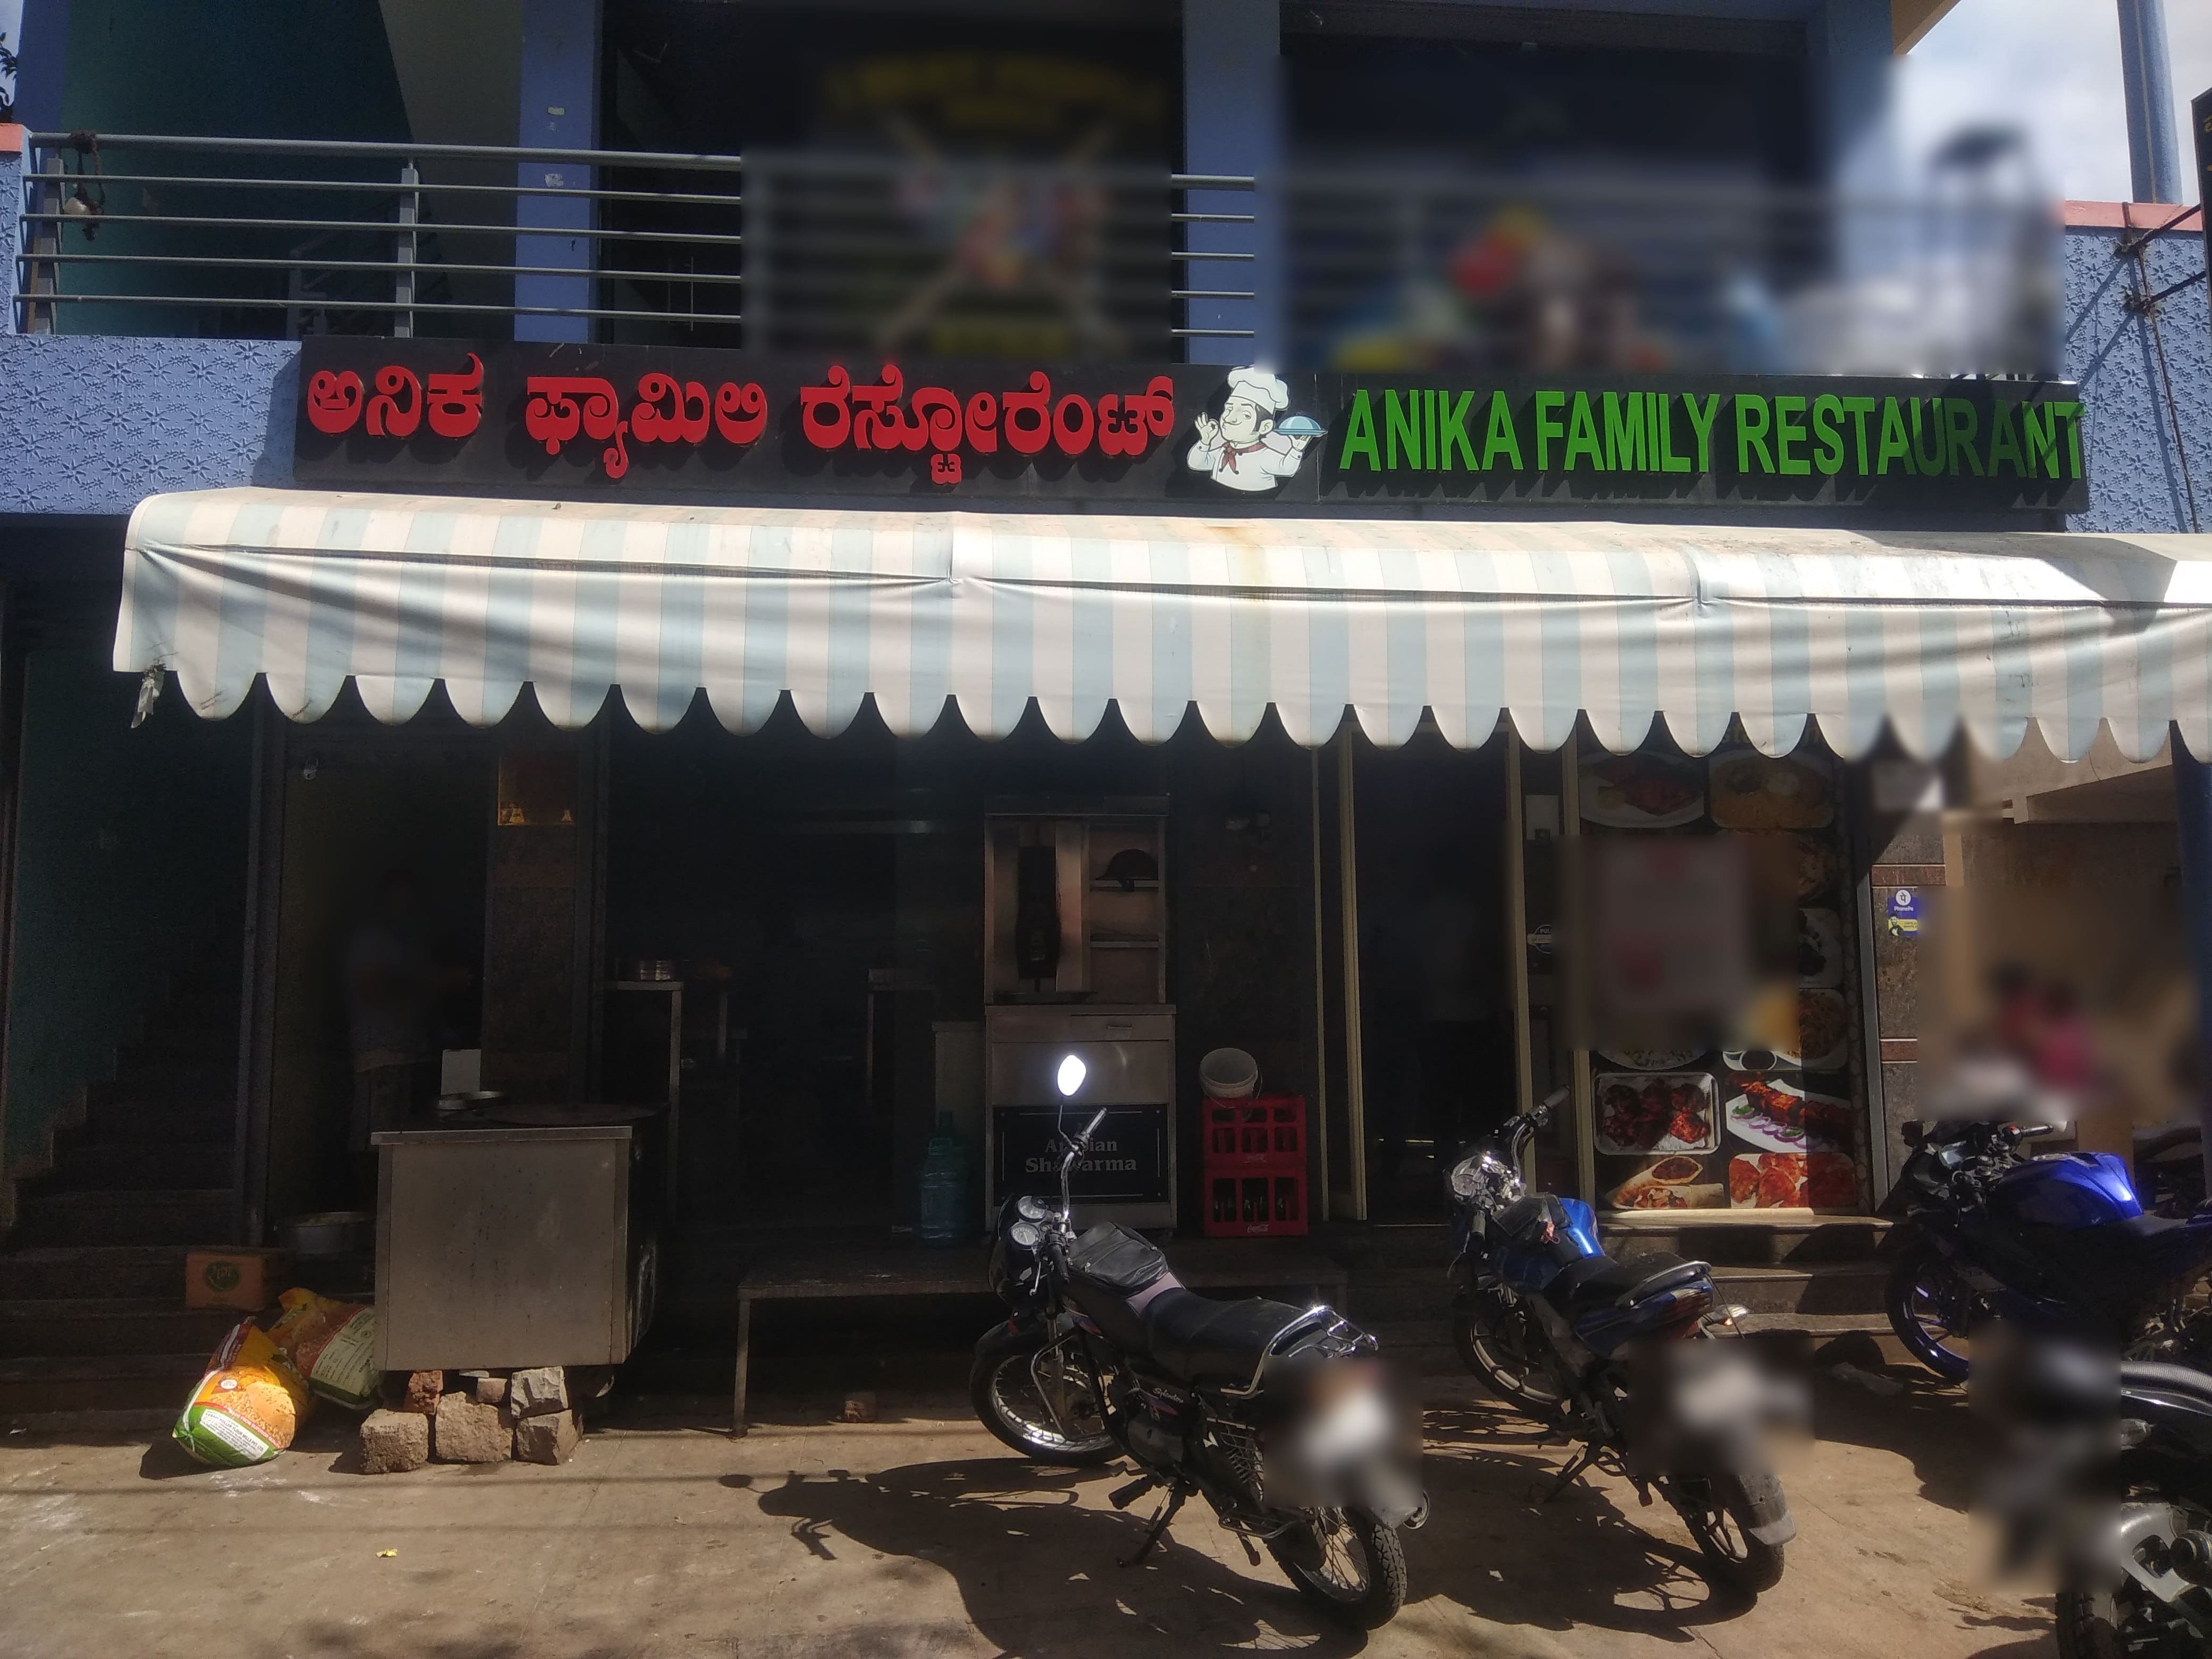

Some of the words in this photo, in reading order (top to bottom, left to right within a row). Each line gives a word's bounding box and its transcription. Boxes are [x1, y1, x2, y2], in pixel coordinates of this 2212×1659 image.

[307, 352, 483, 438] ಅನಿಕ
[525, 372, 768, 479] ಫ್ಯಾಮಿಲಿ
[799, 363, 1175, 485] ರೆಸ್ಟೋರೆಂಟ್
[1339, 389, 1524, 471] ANIKA
[1535, 390, 1720, 473] FAMILY
[1735, 393, 2085, 479] RESTAURANT
[1025, 1157, 1137, 1173] Sharma
[1045, 1137, 1118, 1153] Arian
